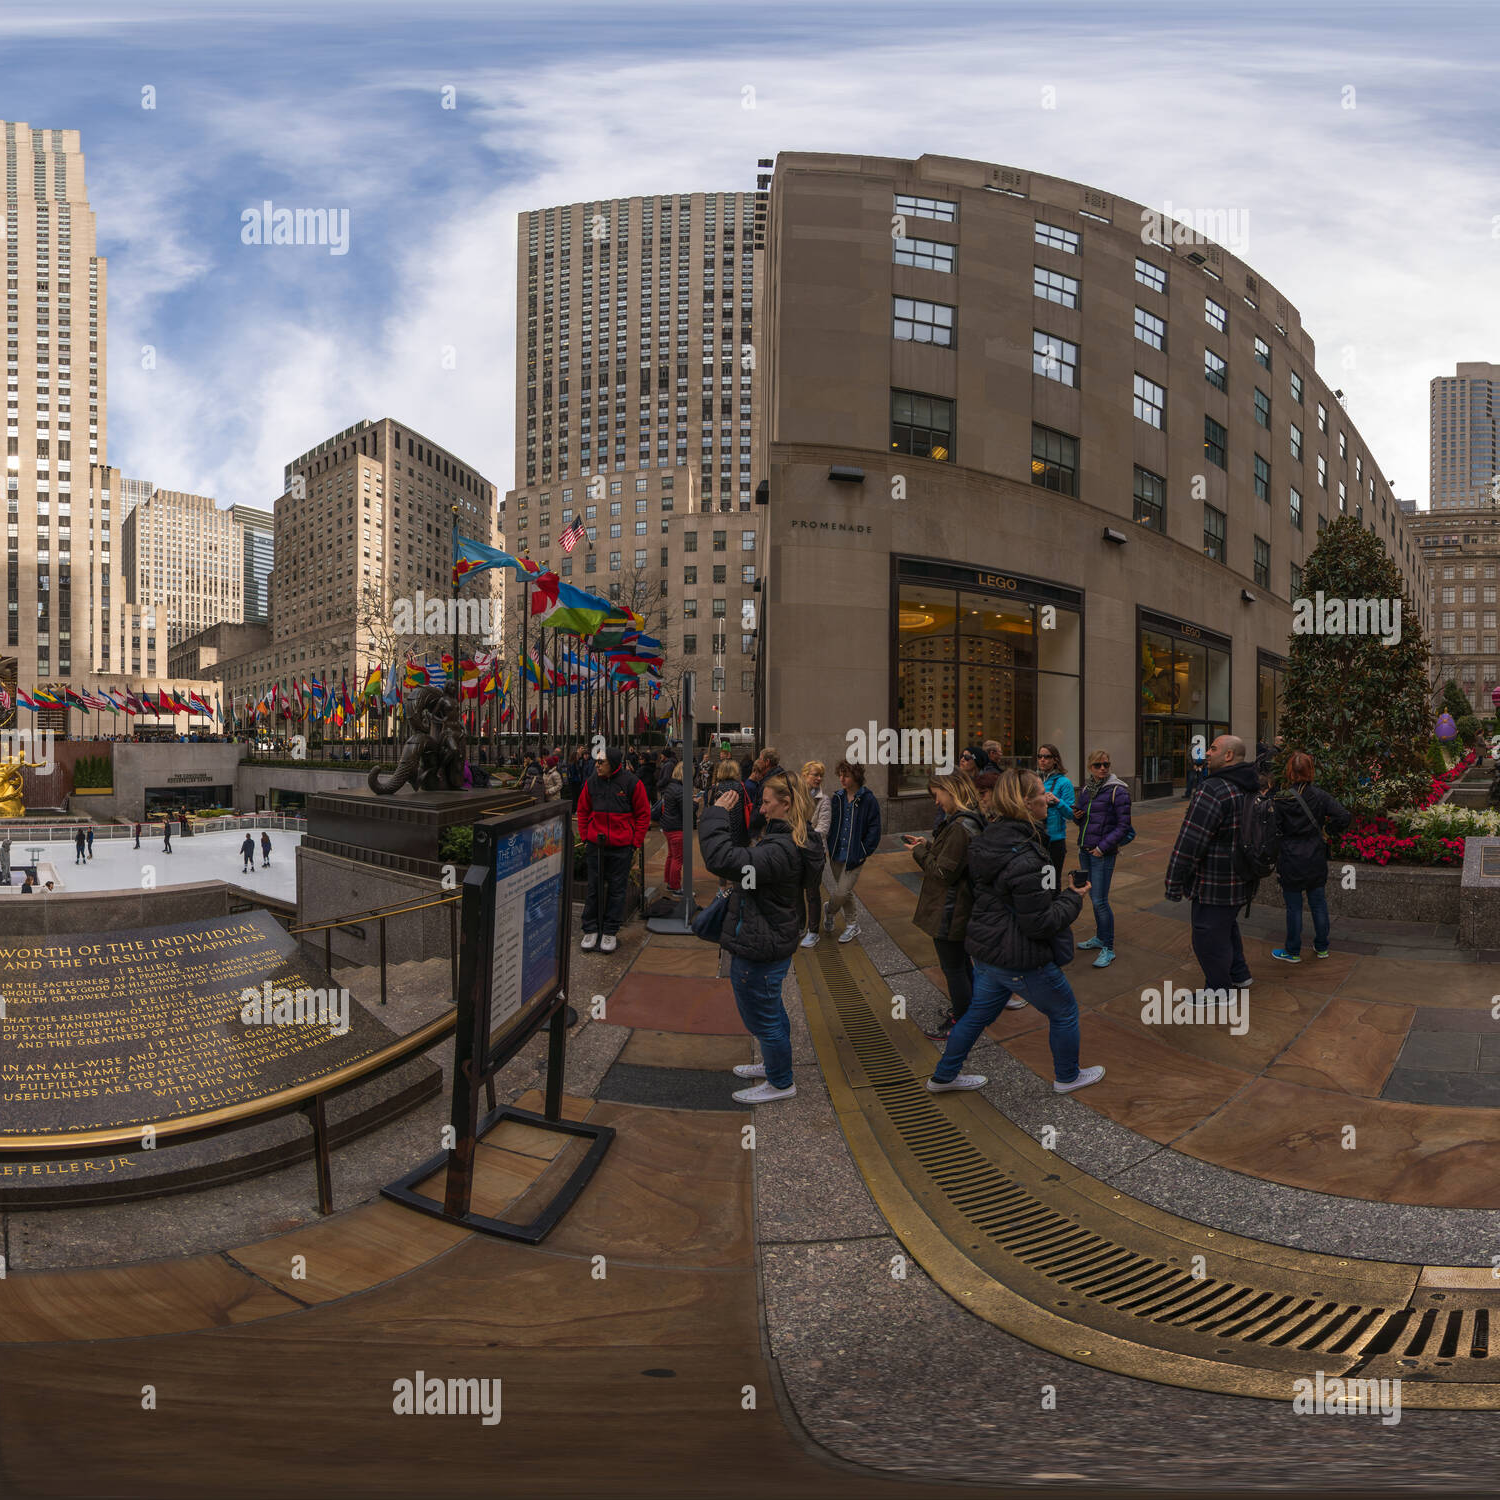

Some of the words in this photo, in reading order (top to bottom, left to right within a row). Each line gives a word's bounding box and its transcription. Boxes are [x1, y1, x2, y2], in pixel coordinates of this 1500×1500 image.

[792, 520, 872, 533] PROMENADE
[978, 573, 1017, 590] LEGO
[1181, 624, 1201, 638] LEGO
[4, 960, 42, 970] AND
[49, 958, 82, 968] THE
[88, 950, 158, 966] PURSUIT
[164, 947, 183, 957] OF
[189, 933, 266, 953] HAPPINESS
[78, 944, 100, 955] OF
[106, 940, 144, 952] THE
[151, 923, 259, 948] INDIVIDUAL
[48, 1039, 71, 1047] THE
[77, 1031, 145, 1046] GREATNESS
[150, 1028, 164, 1036] OF
[168, 1023, 189, 1033] THE
[193, 1014, 236, 1028] HUMAN
[147, 1042, 153, 1050] I
[158, 1030, 218, 1048] BELIEVE
[1, 1071, 76, 1081] WHATEVER
[128, 1061, 155, 1072] AND
[158, 1055, 190, 1066] THAT
[194, 1049, 218, 1060] THE
[3, 1063, 18, 1072] IN
[26, 1063, 46, 1072] AN
[128, 1051, 156, 1062] AND
[3, 1088, 98, 1101] USEFULNESS
[104, 1084, 130, 1094] ARE
[134, 1080, 153, 1090] TO
[157, 1077, 174, 1086] BE
[179, 1066, 225, 1082] FOUND
[228, 1062, 244, 1070] IN
[246, 1049, 288, 1067] LIVING
[290, 1044, 303, 1053] IN
[127, 1062, 196, 1081] GREATEST
[275, 1037, 297, 1051] AND
[152, 1084, 193, 1096] WITH
[197, 1077, 223, 1088] HIS
[228, 1068, 261, 1079] WILL
[108, 1157, 137, 1171] JR
